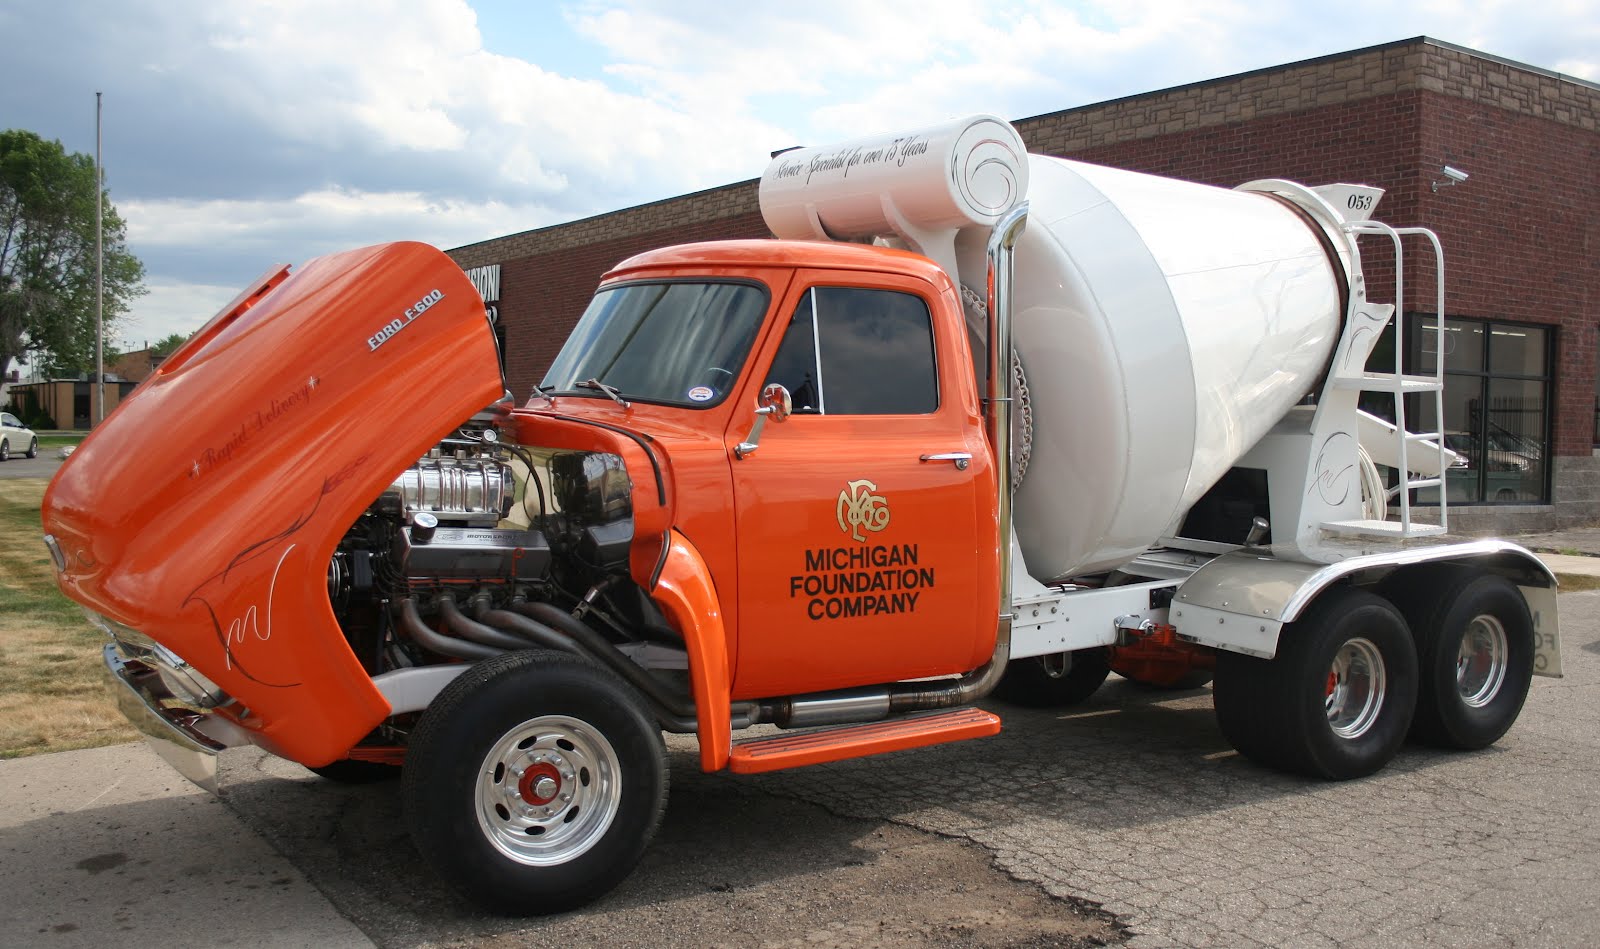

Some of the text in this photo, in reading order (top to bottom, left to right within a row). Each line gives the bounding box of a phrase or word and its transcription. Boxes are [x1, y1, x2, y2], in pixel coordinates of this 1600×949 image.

[805, 148, 850, 185] Specialist
[844, 146, 863, 178] for
[863, 148, 884, 164] over
[898, 135, 930, 167] Years
[1347, 194, 1373, 210] 053
[367, 318, 403, 350] FORD
[200, 423, 248, 468] Rapid
[805, 544, 918, 572] MICHIGAN
[790, 568, 935, 598] FOUNDATION
[807, 592, 920, 620] COMPANY
